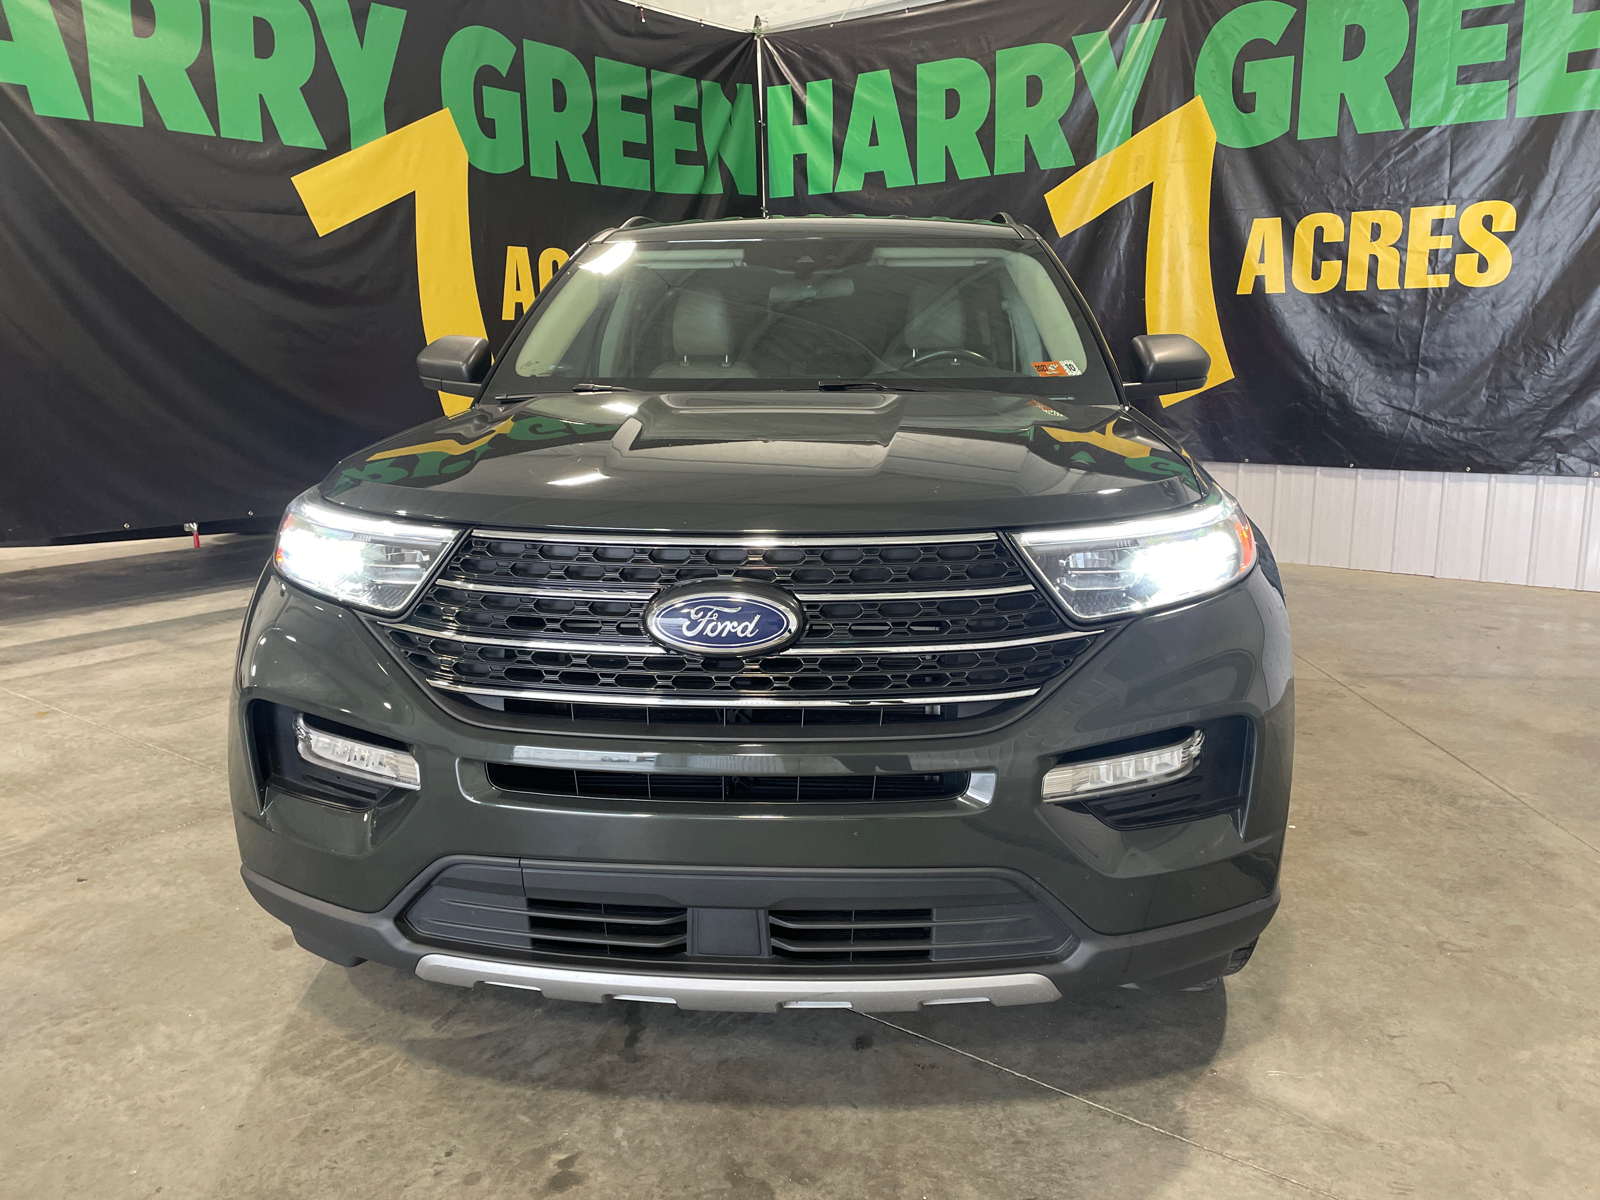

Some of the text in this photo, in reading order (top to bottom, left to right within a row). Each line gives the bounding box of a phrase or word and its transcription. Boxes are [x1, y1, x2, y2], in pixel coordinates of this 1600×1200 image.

[440, 25, 759, 197] GREEN
[765, 17, 1166, 200] HARRY
[291, 107, 495, 420] 7
[1044, 94, 1517, 408] 7 ACRES
[682, 605, 761, 638] Ford
